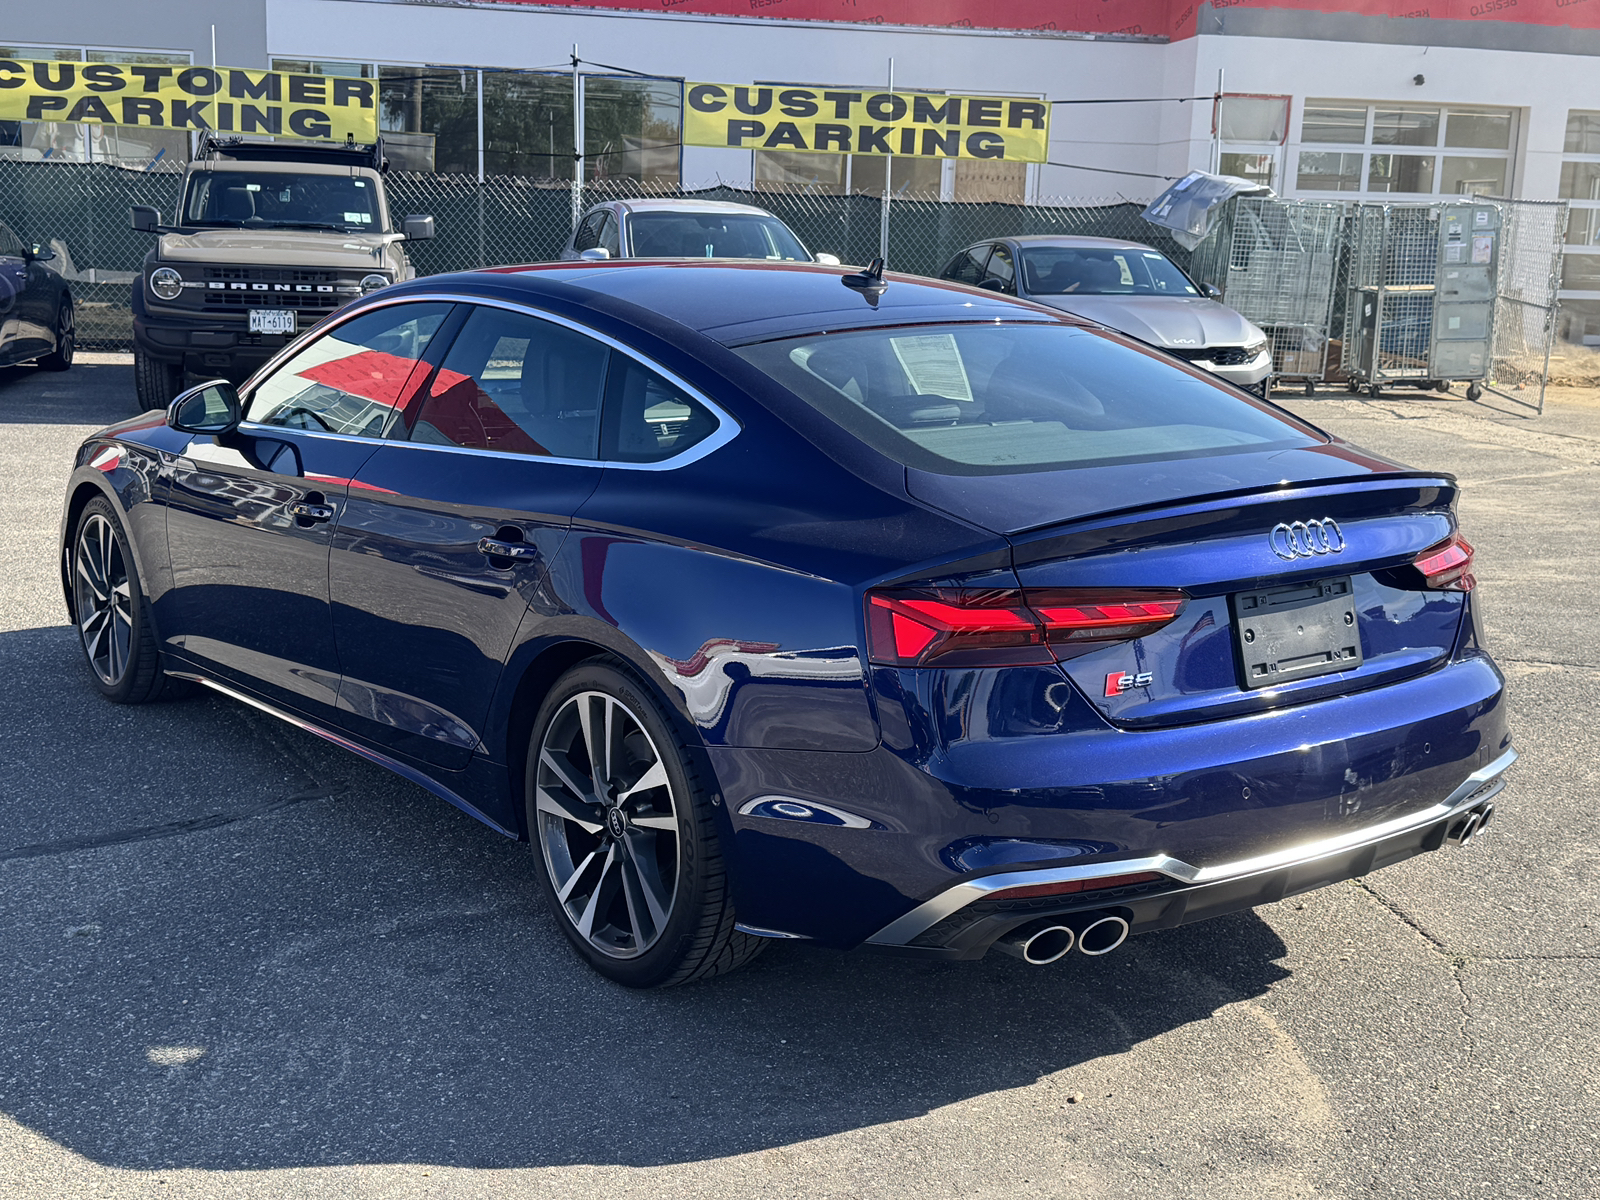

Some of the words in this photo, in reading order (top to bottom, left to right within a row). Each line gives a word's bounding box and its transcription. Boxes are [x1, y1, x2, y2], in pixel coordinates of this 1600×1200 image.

[1470, 0, 1518, 16] RESISTO
[0, 60, 375, 109] CUSTOMER
[26, 95, 332, 138] PARKING
[688, 84, 1046, 130] CUSTOMER
[727, 119, 1005, 159] PARKING
[208, 281, 334, 293] BRONCO
[1116, 671, 1153, 691] S5
